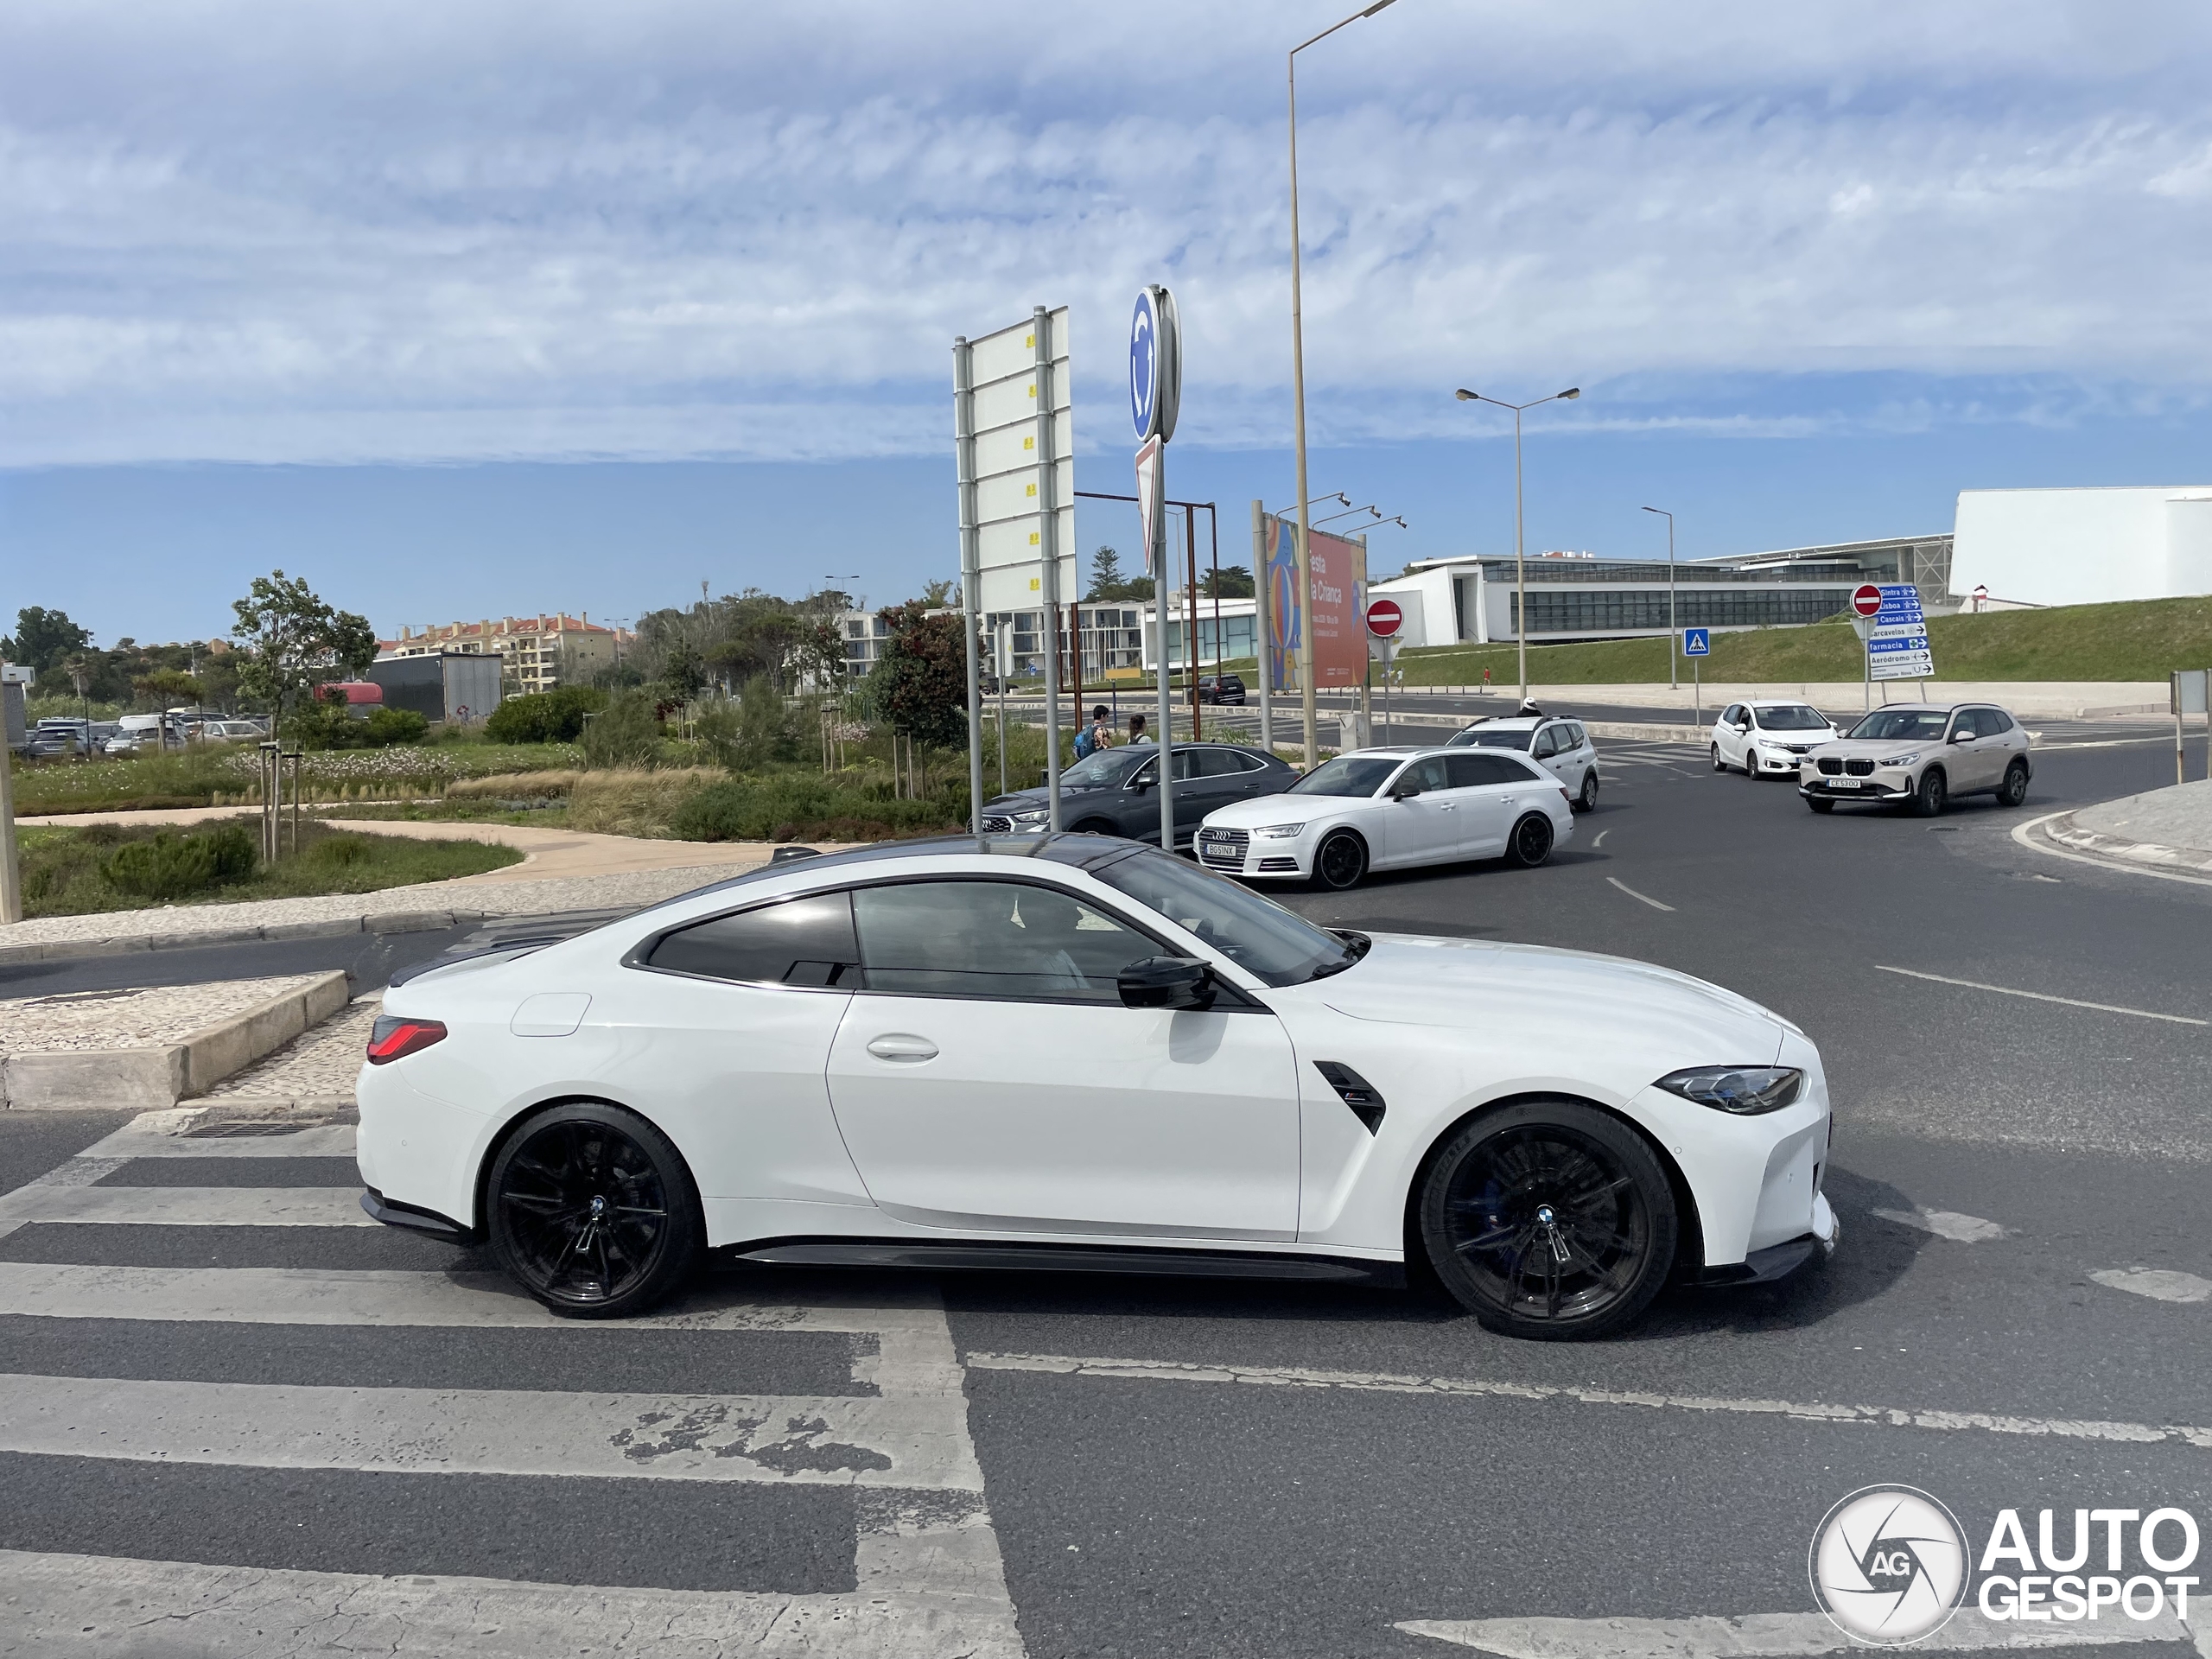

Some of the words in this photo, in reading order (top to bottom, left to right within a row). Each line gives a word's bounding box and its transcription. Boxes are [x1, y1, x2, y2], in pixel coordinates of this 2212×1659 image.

[1309, 550, 1325, 574] esta
[1318, 578, 1342, 608] Criança
[1871, 628, 1904, 637] arcavelos
[1872, 655, 1910, 664] Aeródromo
